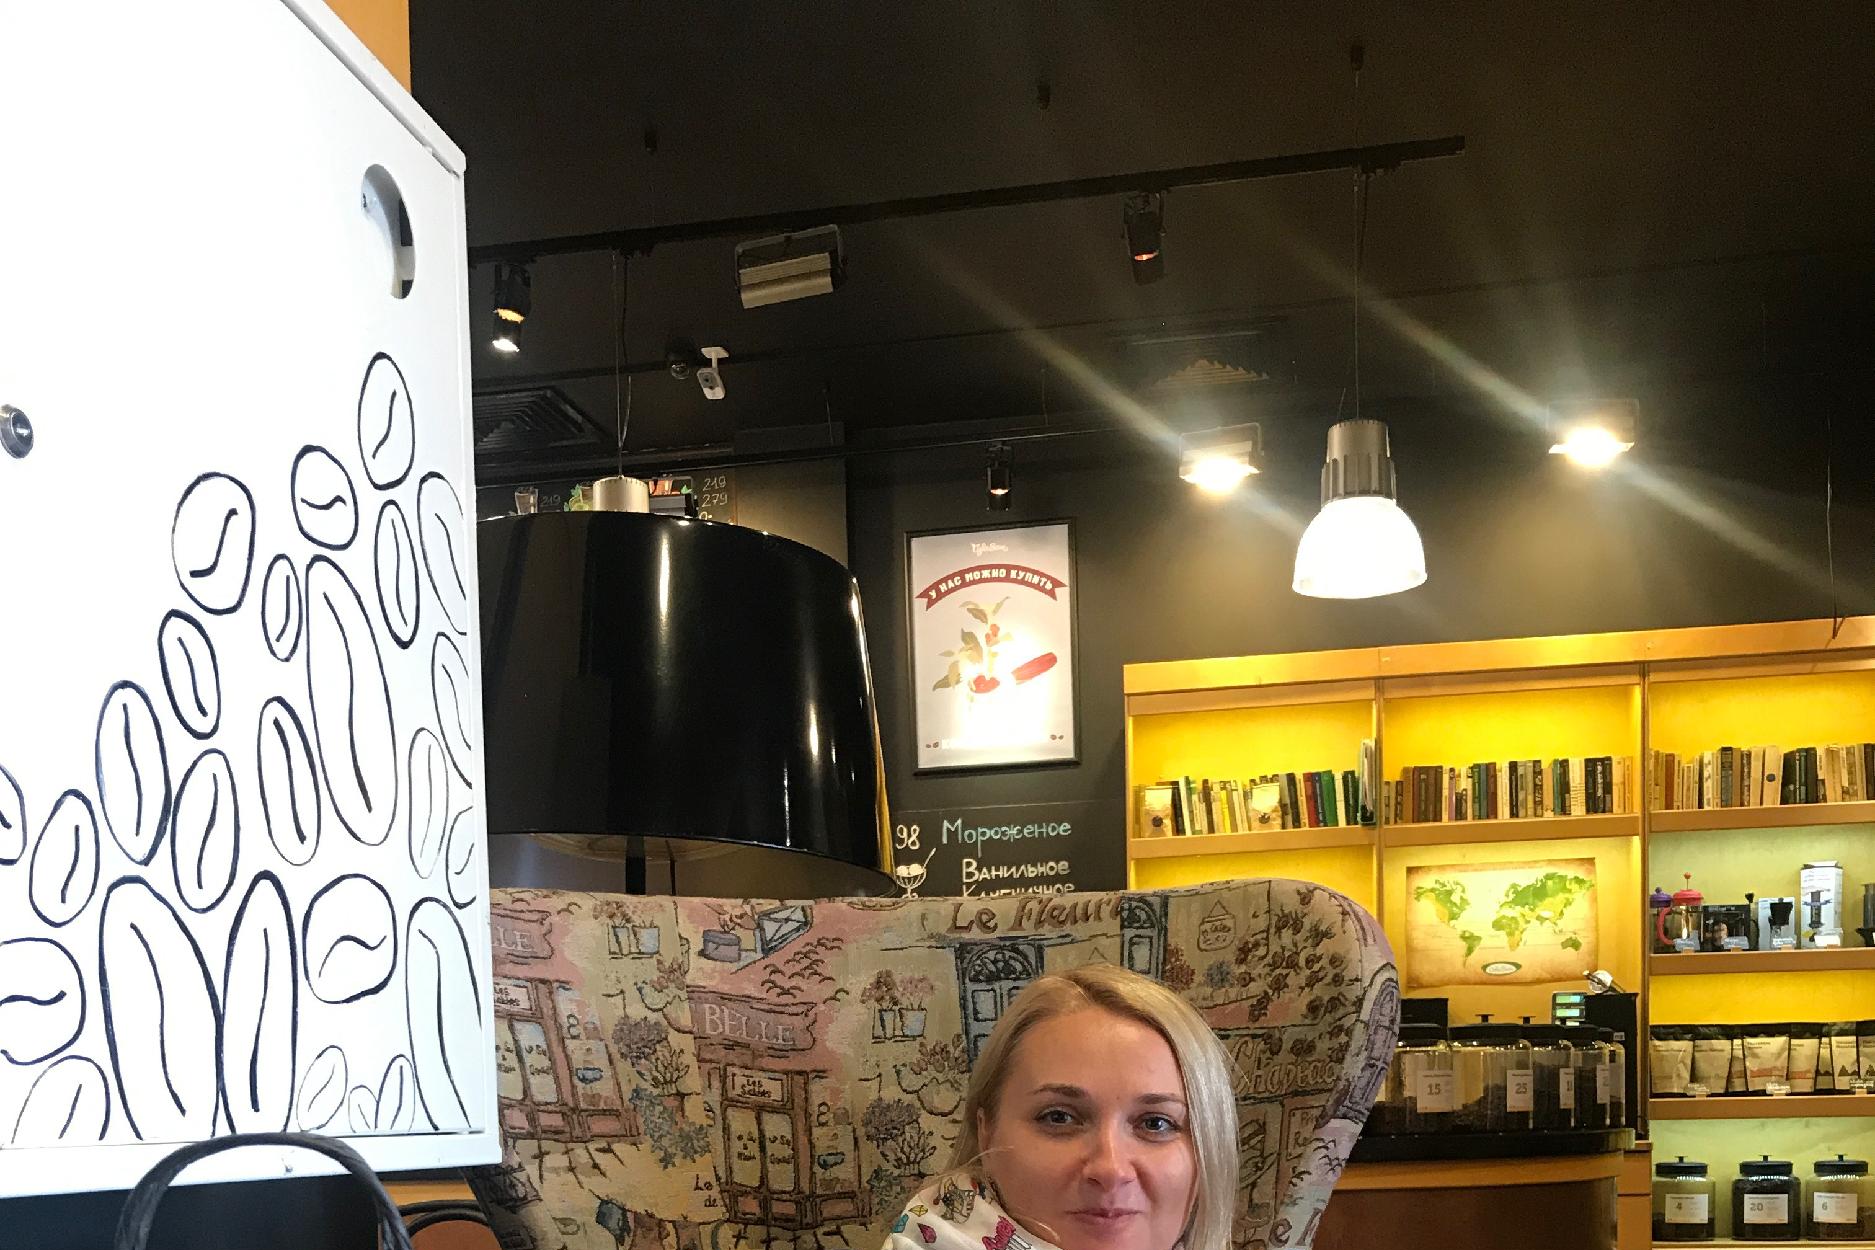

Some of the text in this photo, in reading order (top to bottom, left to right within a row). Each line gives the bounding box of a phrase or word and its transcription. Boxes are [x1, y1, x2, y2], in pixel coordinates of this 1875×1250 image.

[702, 476, 726, 491] 219
[702, 493, 728, 507] 279
[928, 568, 1053, 600] У НАС МОЖНО КУПИТЬ
[896, 824, 921, 850] 98
[941, 817, 1072, 858] Мороженое
[946, 902, 998, 935] Le
[703, 1002, 796, 1045] BELLE
[1427, 1083, 1441, 1096] 15
[1514, 1082, 1528, 1095] 25
[1749, 1202, 1764, 1212] 20
[1821, 1201, 1828, 1211] 6
